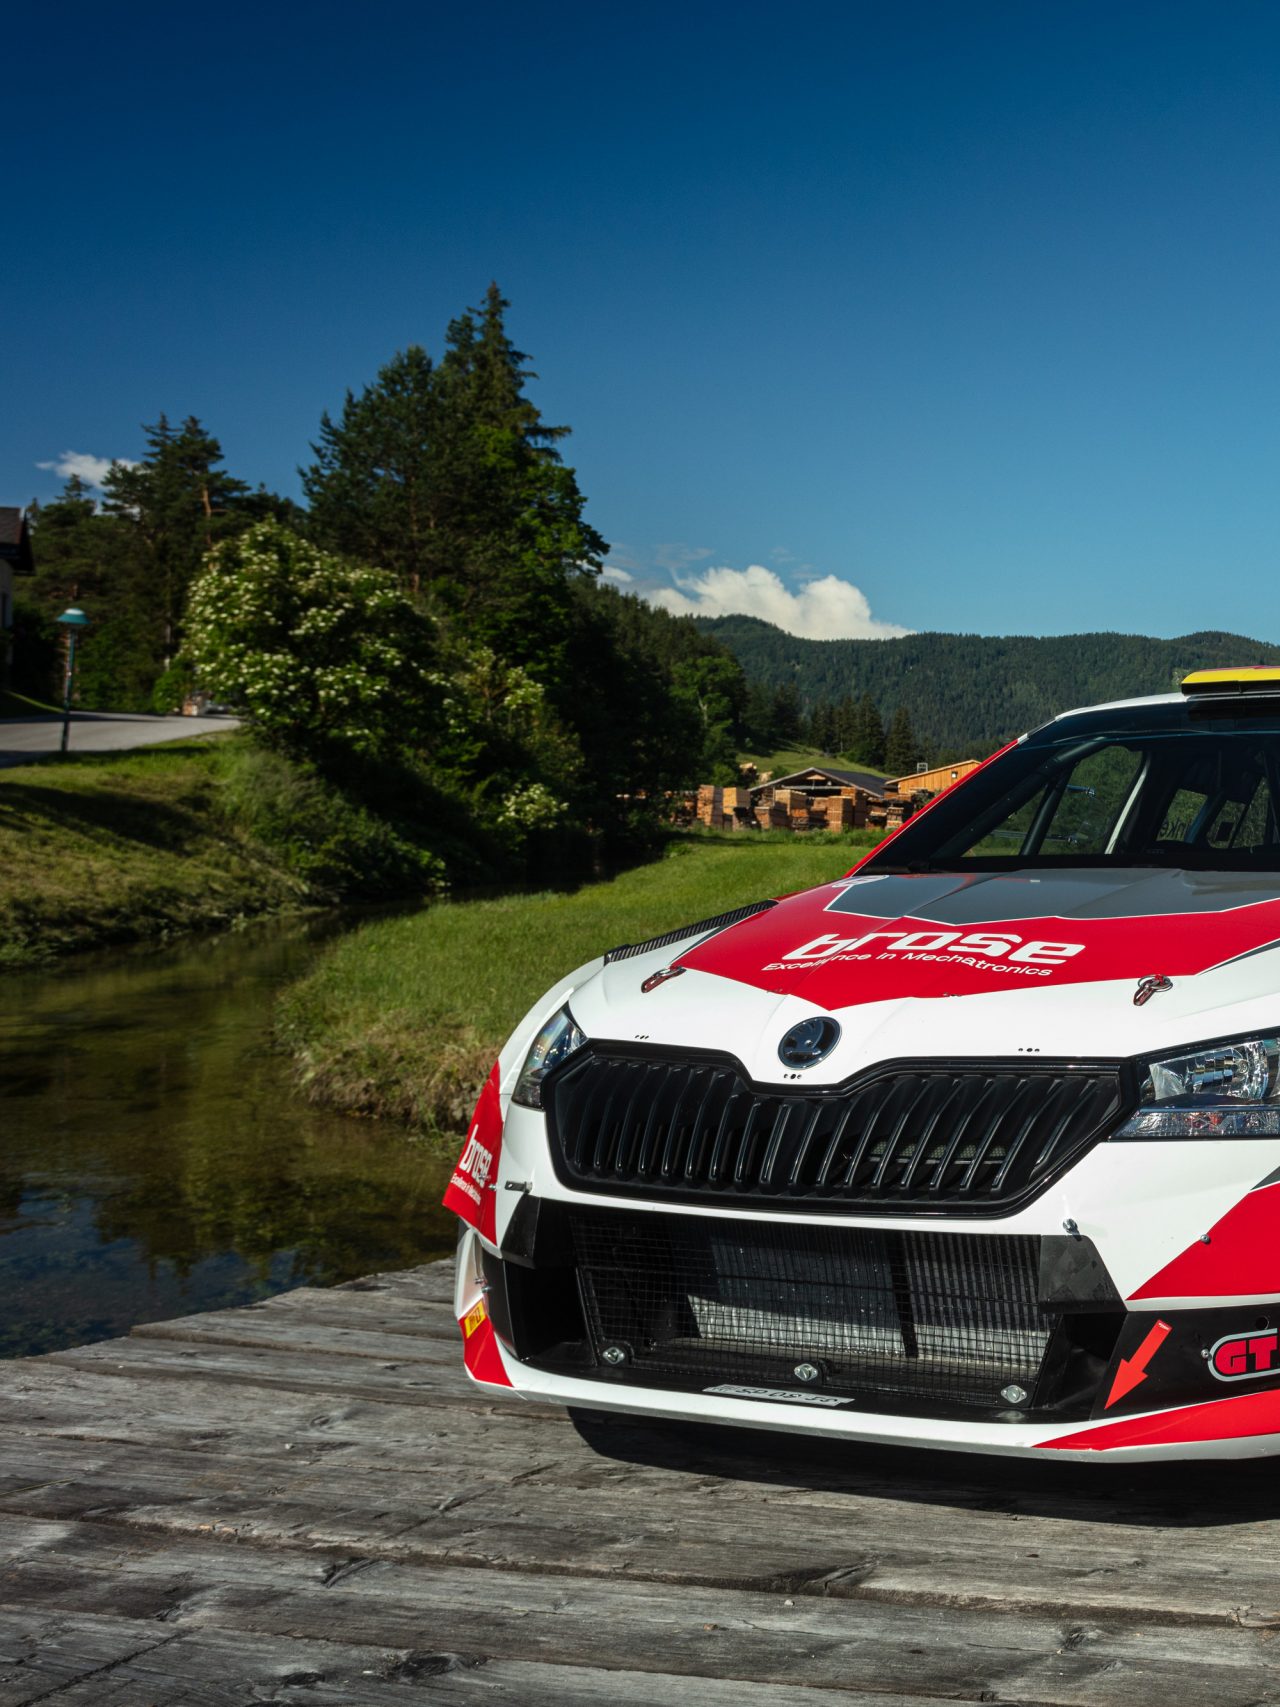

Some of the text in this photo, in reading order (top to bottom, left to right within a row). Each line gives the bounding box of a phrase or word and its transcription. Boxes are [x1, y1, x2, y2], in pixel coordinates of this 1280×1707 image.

[781, 932, 1086, 964] brose
[876, 952, 897, 961] in
[901, 952, 1053, 976] Mechatronics
